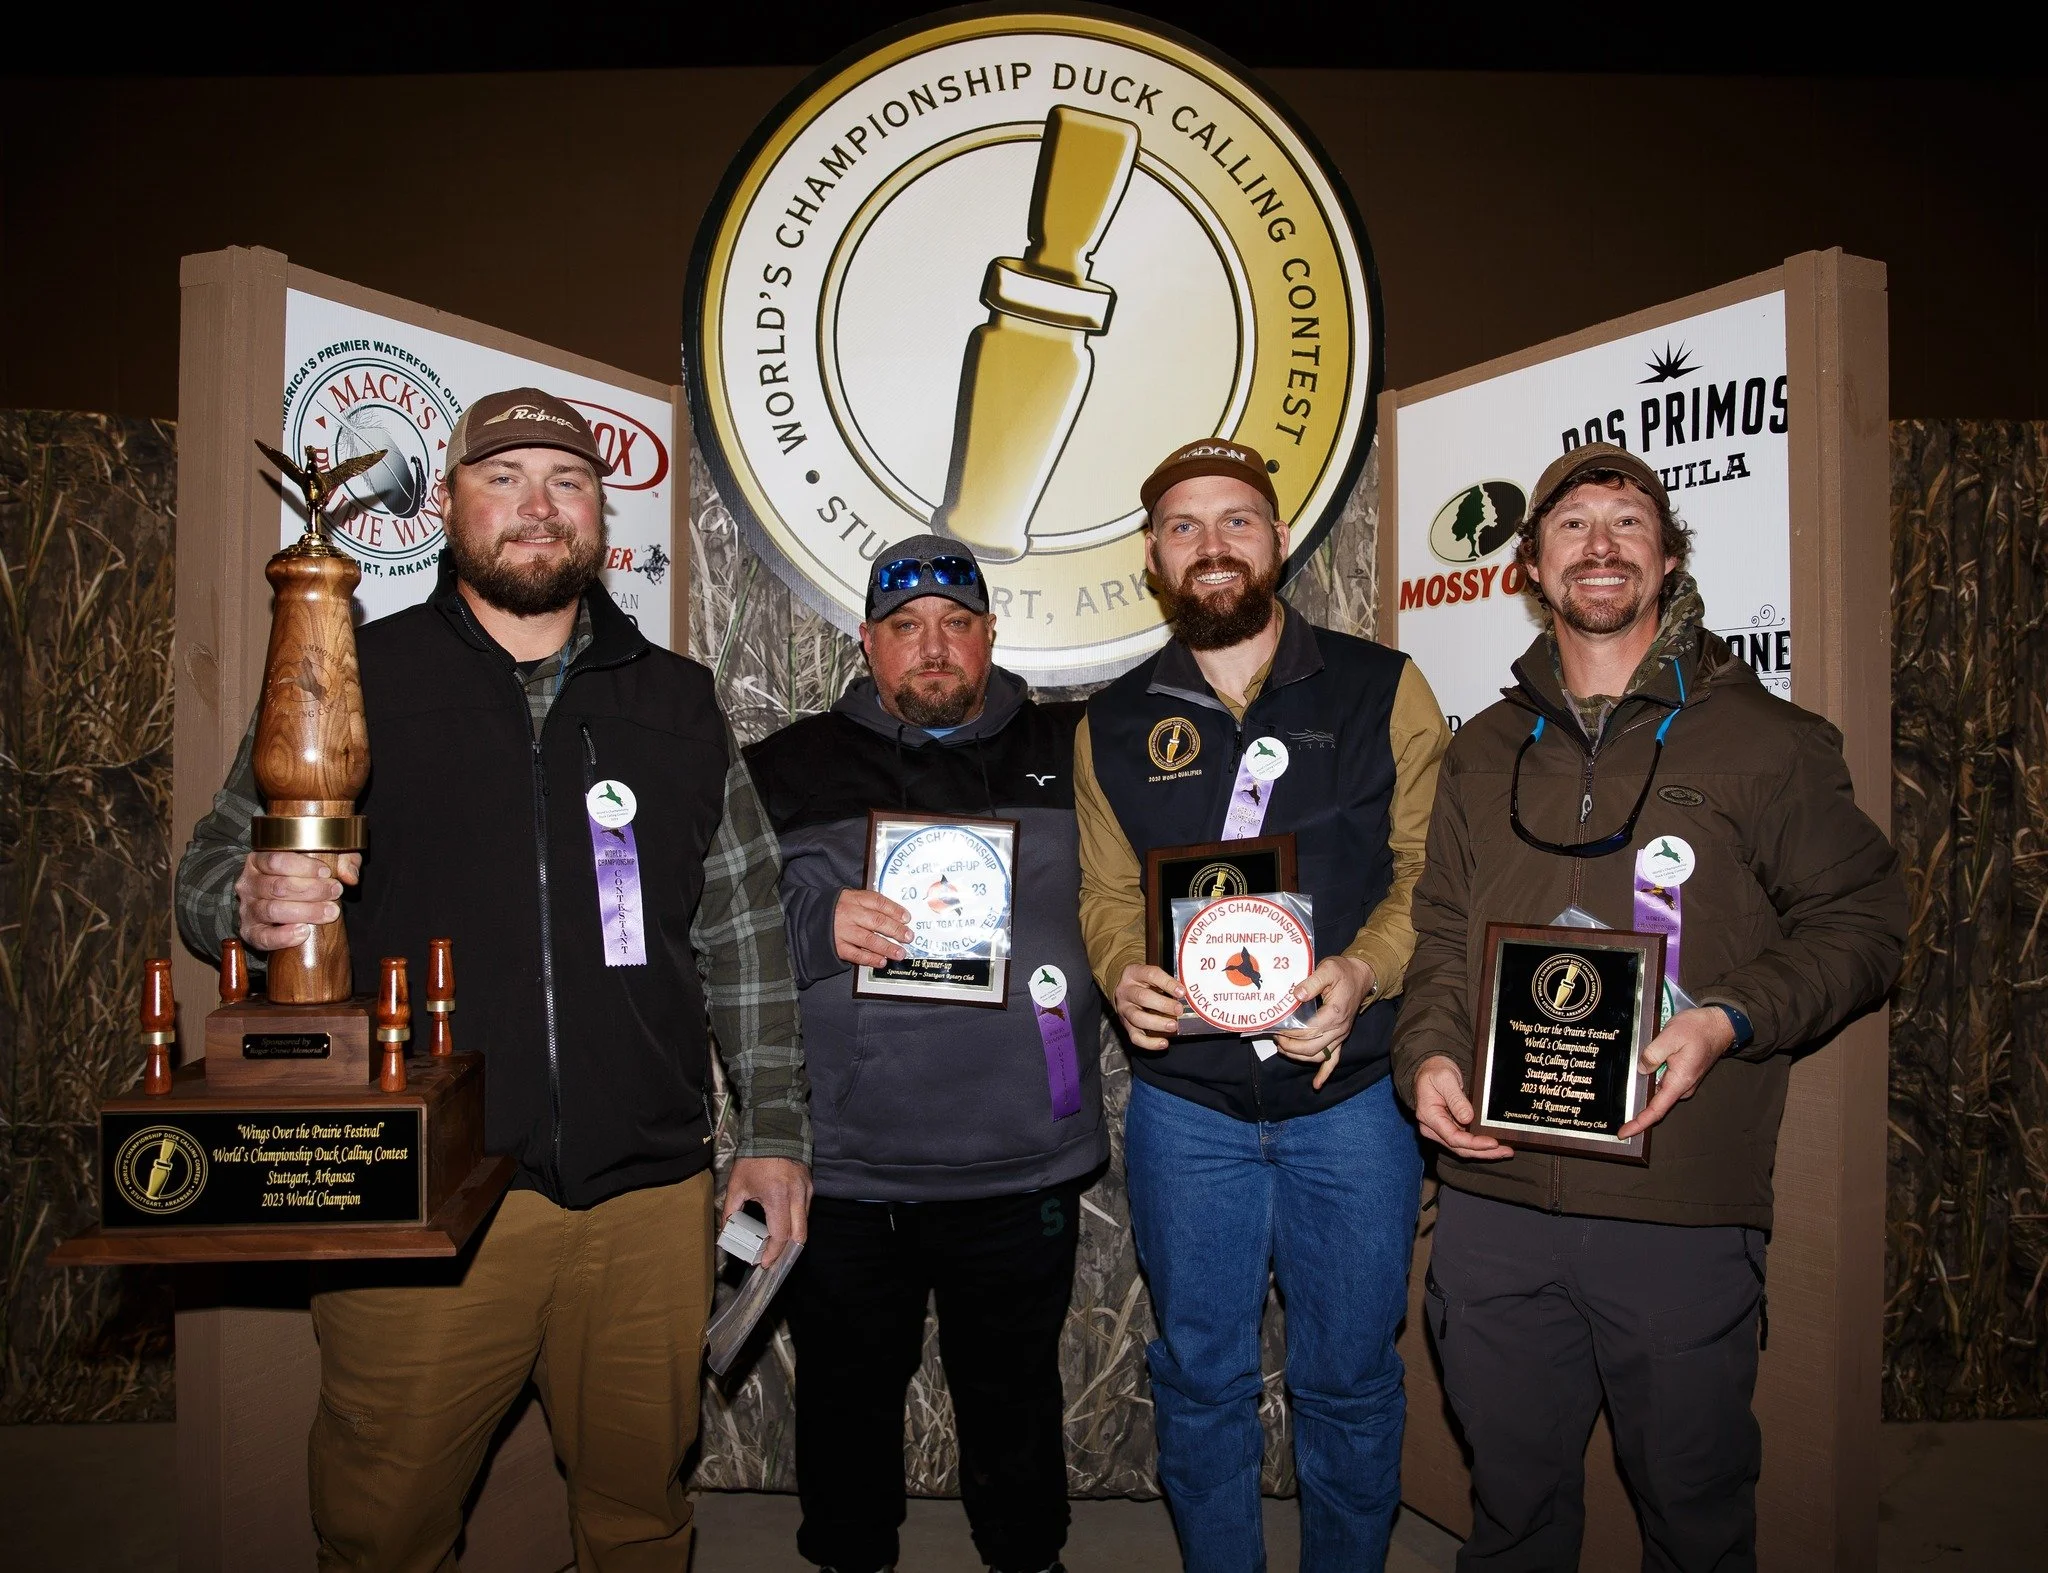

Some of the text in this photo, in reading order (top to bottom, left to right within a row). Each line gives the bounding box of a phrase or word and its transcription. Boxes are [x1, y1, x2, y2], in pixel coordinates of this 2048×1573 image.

[757, 62, 1320, 455] WORLD'S CHAMPIONSHIP DUCK CALLING CONTEST
[317, 340, 371, 363] PREMIER
[373, 340, 441, 388] WATERFOWL
[328, 372, 438, 432] MACK'S
[1561, 373, 1788, 455] DOS PRIMOS
[1653, 453, 1750, 493] UILA
[389, 552, 440, 577] ARKANS
[1399, 565, 1500, 611] MOSSY
[1178, 769, 1203, 778] QUALIFIER
[888, 837, 925, 876] WORLD'S
[901, 886, 917, 901] 20
[1188, 903, 1303, 946] WORLD'S CHAMPIONSHIP
[1205, 933, 1284, 945] 2nd RUNNER-UP
[1200, 956, 1289, 970] 20 23
[1189, 983, 1213, 1013] DUCK
[1211, 1007, 1258, 1025] CALLING
[1213, 992, 1275, 1002] STUTTGART, AR
[1534, 1023, 1551, 1034] Over
[1552, 1024, 1562, 1035] the
[1563, 1025, 1586, 1038] Prairie
[1552, 1040, 1600, 1057] Championship
[1525, 1052, 1596, 1069] Duck Calling Contest
[1559, 1071, 1593, 1085] Arkansas
[1520, 1083, 1596, 1102] 2023 World Champion
[1531, 1099, 1581, 1118] 3rd Runner-up
[1503, 1111, 1534, 1119] Sponsored
[1532, 1113, 1540, 1122] by
[1545, 1116, 1572, 1126] Stuttgart
[1573, 1119, 1593, 1129] Rotary
[1593, 1121, 1608, 1129] Club
[272, 1125, 295, 1139] Over
[295, 1123, 310, 1139] the
[311, 1123, 342, 1139] Prairie
[125, 1132, 162, 1159] CHAMPIONSHIP
[164, 1132, 180, 1141] DUCK
[180, 1138, 198, 1159] CALLING
[193, 1159, 201, 1185] CONTEST
[213, 1145, 408, 1166] World's Championship Duck Calling Contest
[267, 1168, 356, 1188] Stuttgart, Arkansas
[164, 1189, 194, 1207] ARKANSAS
[261, 1190, 361, 1210] 2023 World Champion
